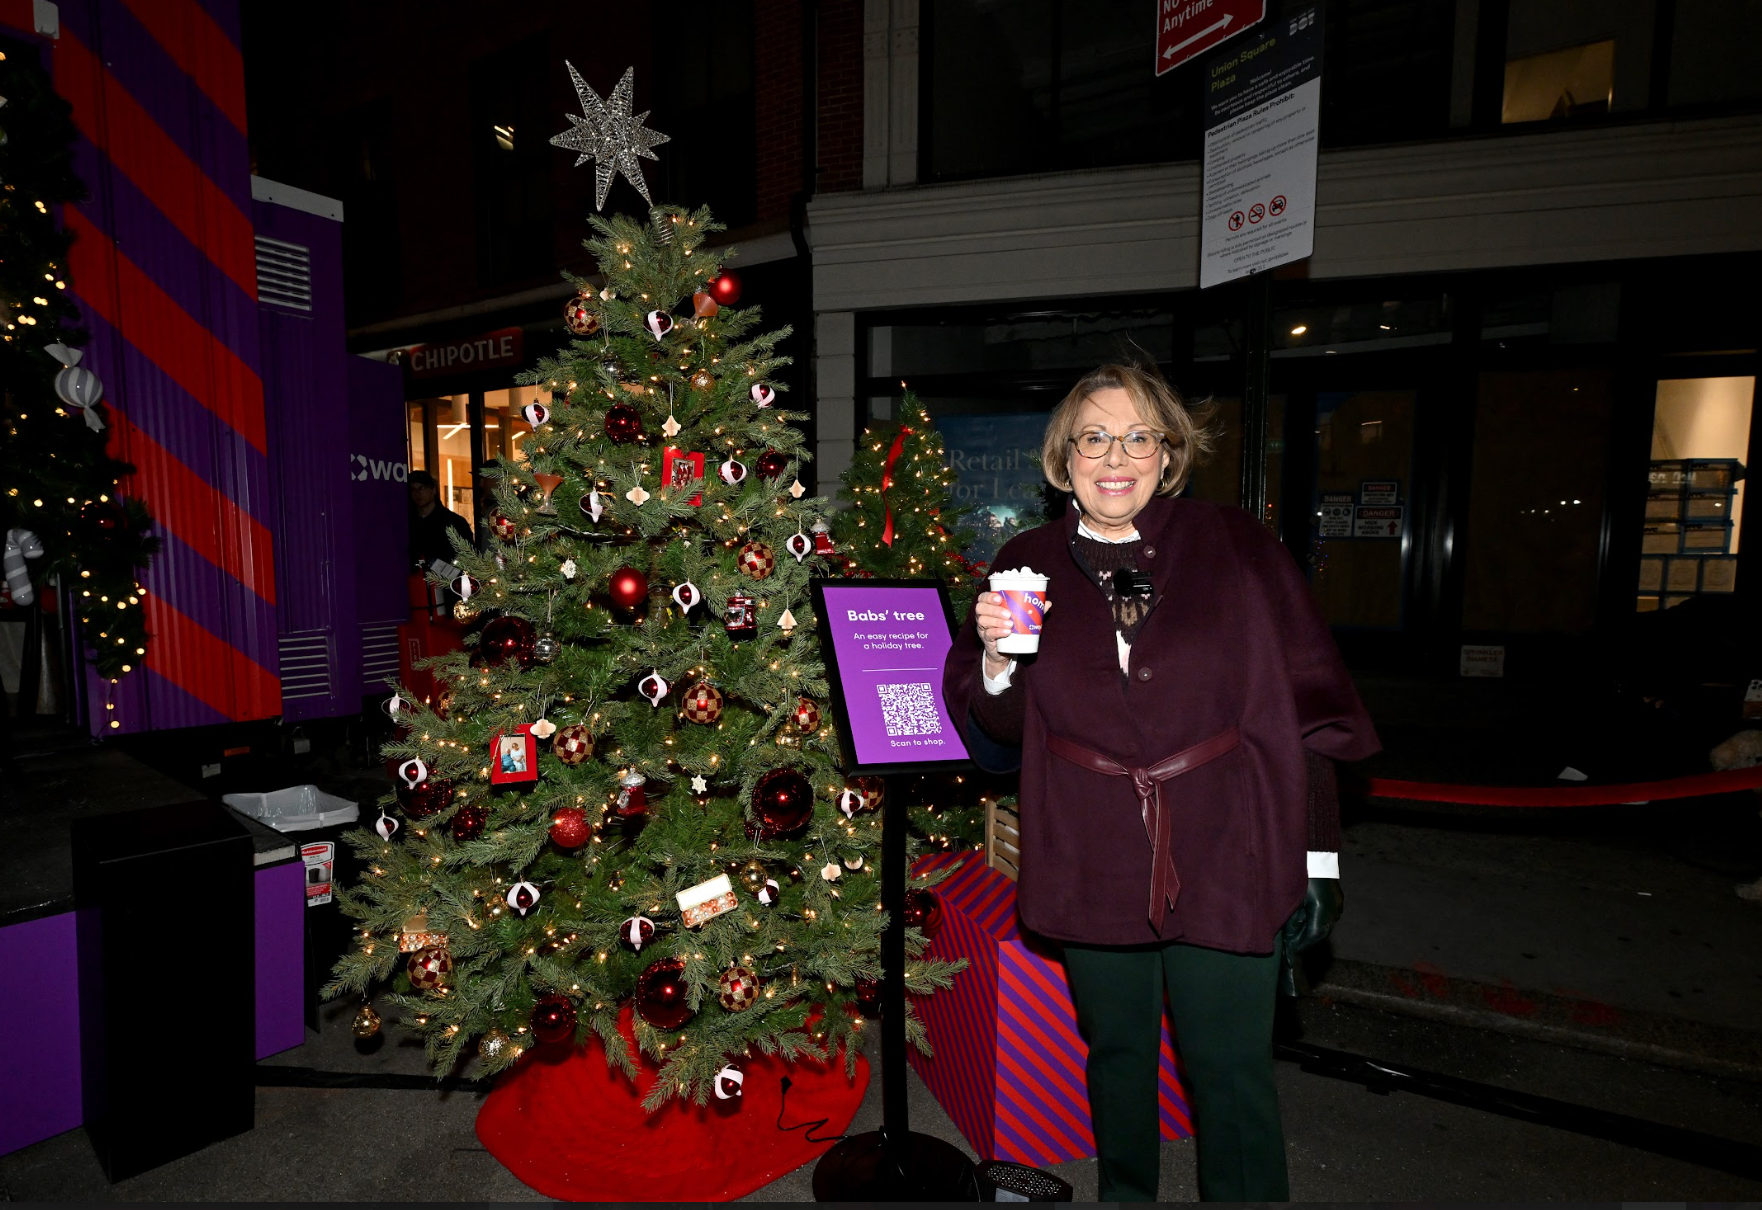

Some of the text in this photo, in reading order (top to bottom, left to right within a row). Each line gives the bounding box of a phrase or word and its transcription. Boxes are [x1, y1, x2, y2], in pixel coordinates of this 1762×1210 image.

[1163, 0, 1214, 34] Anytime
[1290, 13, 1314, 36] DOT
[1212, 39, 1275, 78] Union Square
[1269, 74, 1278, 82] and
[1279, 63, 1302, 76] enjoyable
[1302, 56, 1315, 65] time.
[1212, 75, 1236, 92] Plaza
[1244, 94, 1252, 102] and
[1253, 81, 1276, 96] respectful
[1301, 64, 1310, 73] and
[1265, 88, 1277, 98] plaza
[1278, 82, 1292, 90] clean.
[1208, 94, 1294, 138] Pedestrian Plaza Rules Prohibit:
[410, 336, 514, 372] CHIPOTLE
[949, 447, 1020, 471] Retail
[847, 610, 925, 622] Babs’ tree
[872, 642, 902, 650] holiday
[889, 632, 915, 641] recipe
[924, 738, 946, 746] shop.
